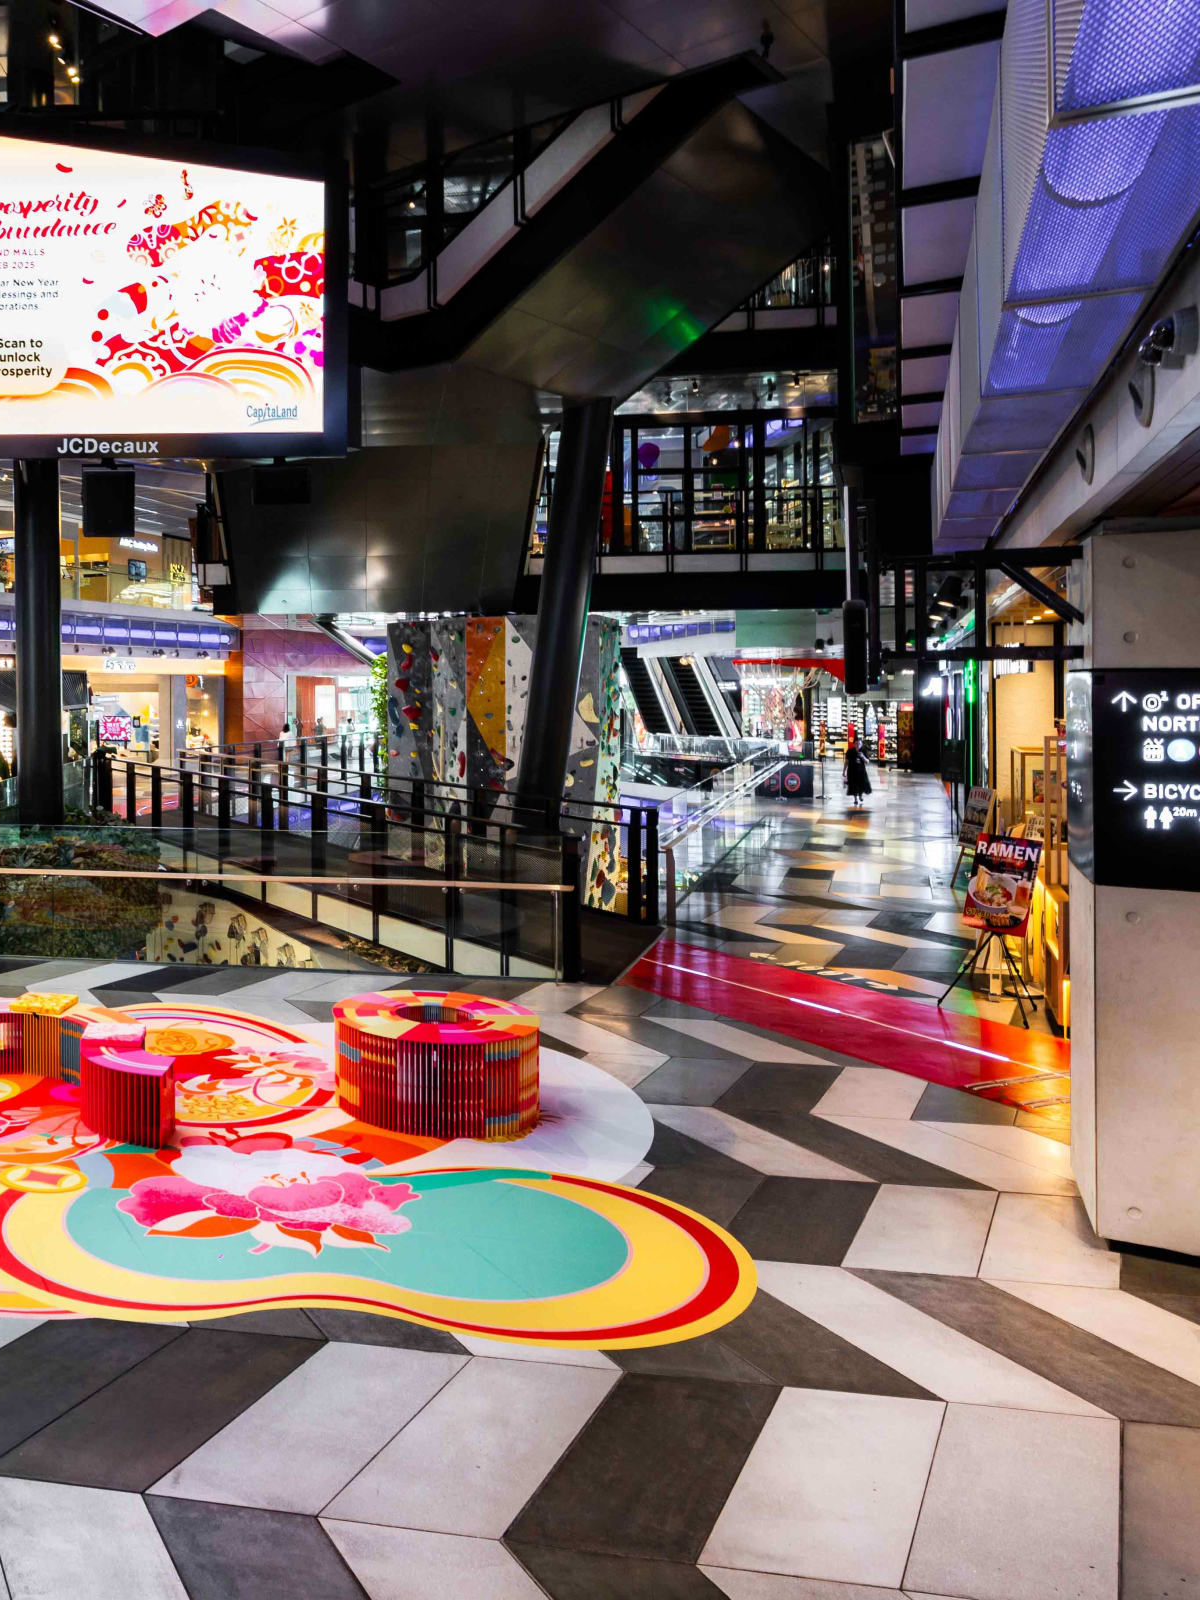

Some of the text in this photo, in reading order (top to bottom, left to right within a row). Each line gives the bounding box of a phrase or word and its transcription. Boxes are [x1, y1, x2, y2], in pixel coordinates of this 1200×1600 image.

[14, 248, 45, 256] MALLS
[12, 261, 35, 269] 2025
[13, 279, 35, 288] New
[37, 278, 59, 287] Year
[41, 289, 59, 299] and
[29, 339, 43, 349] to
[0, 351, 41, 362] unlock
[246, 403, 298, 419] CapitaLand
[57, 437, 159, 454] JCDecaux
[1142, 716, 1200, 732] NORT
[1173, 807, 1197, 817] 20m
[977, 841, 1039, 862] RAMEN
